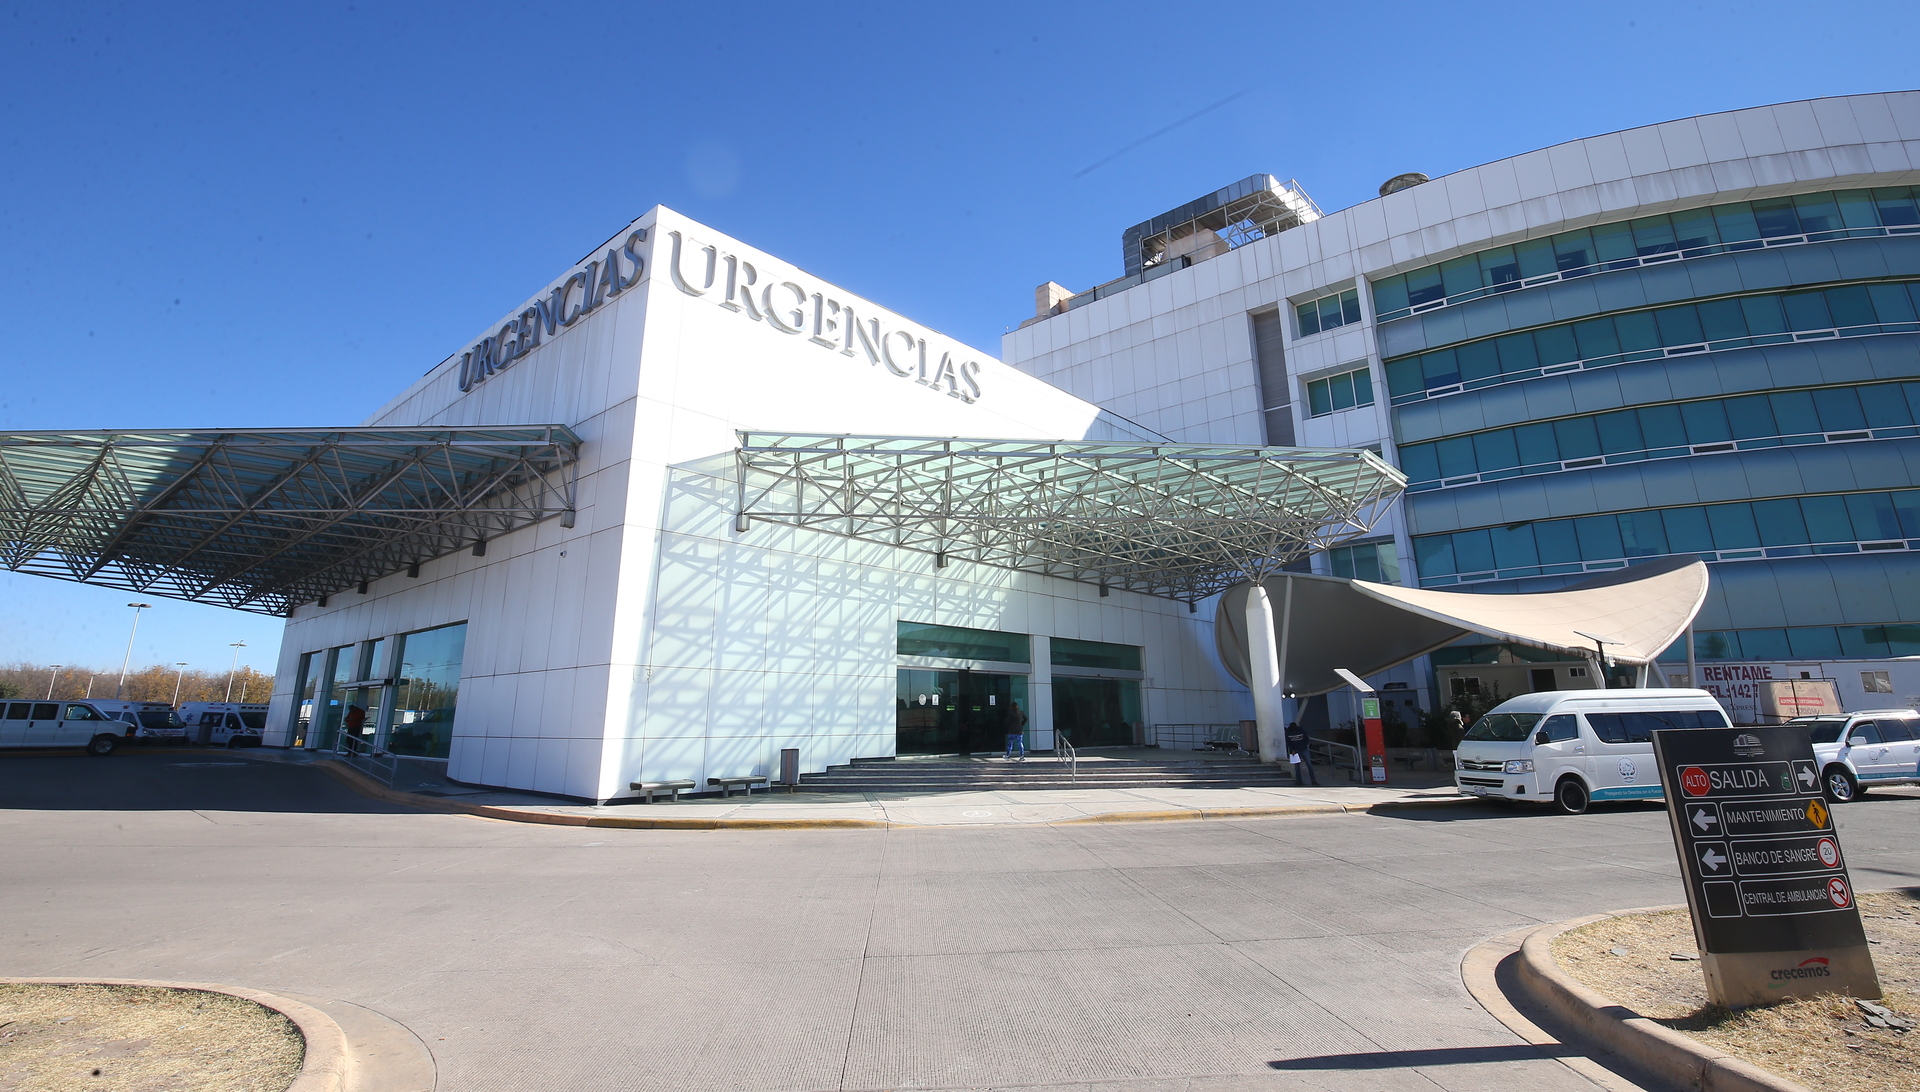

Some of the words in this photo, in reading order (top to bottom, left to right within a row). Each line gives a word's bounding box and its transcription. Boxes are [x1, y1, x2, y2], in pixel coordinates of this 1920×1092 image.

[458, 228, 647, 392] URGENCIAS
[667, 230, 981, 404] URGENCIAS
[1703, 666, 1772, 681] RENTAME
[1686, 774, 1707, 787] ALTO
[1709, 769, 1770, 789] SALIDA
[1726, 808, 1805, 823] MANTENIMIENTO
[1735, 851, 1770, 865] BANCO
[1770, 850, 1784, 864] DE
[1784, 847, 1818, 862] SANGRE
[1823, 846, 1832, 855] 20
[1743, 892, 1776, 904] CENTRAL
[1776, 891, 1787, 903] DE
[1786, 888, 1828, 902] AMBULANCIAS
[1770, 966, 1830, 980] crecemos
